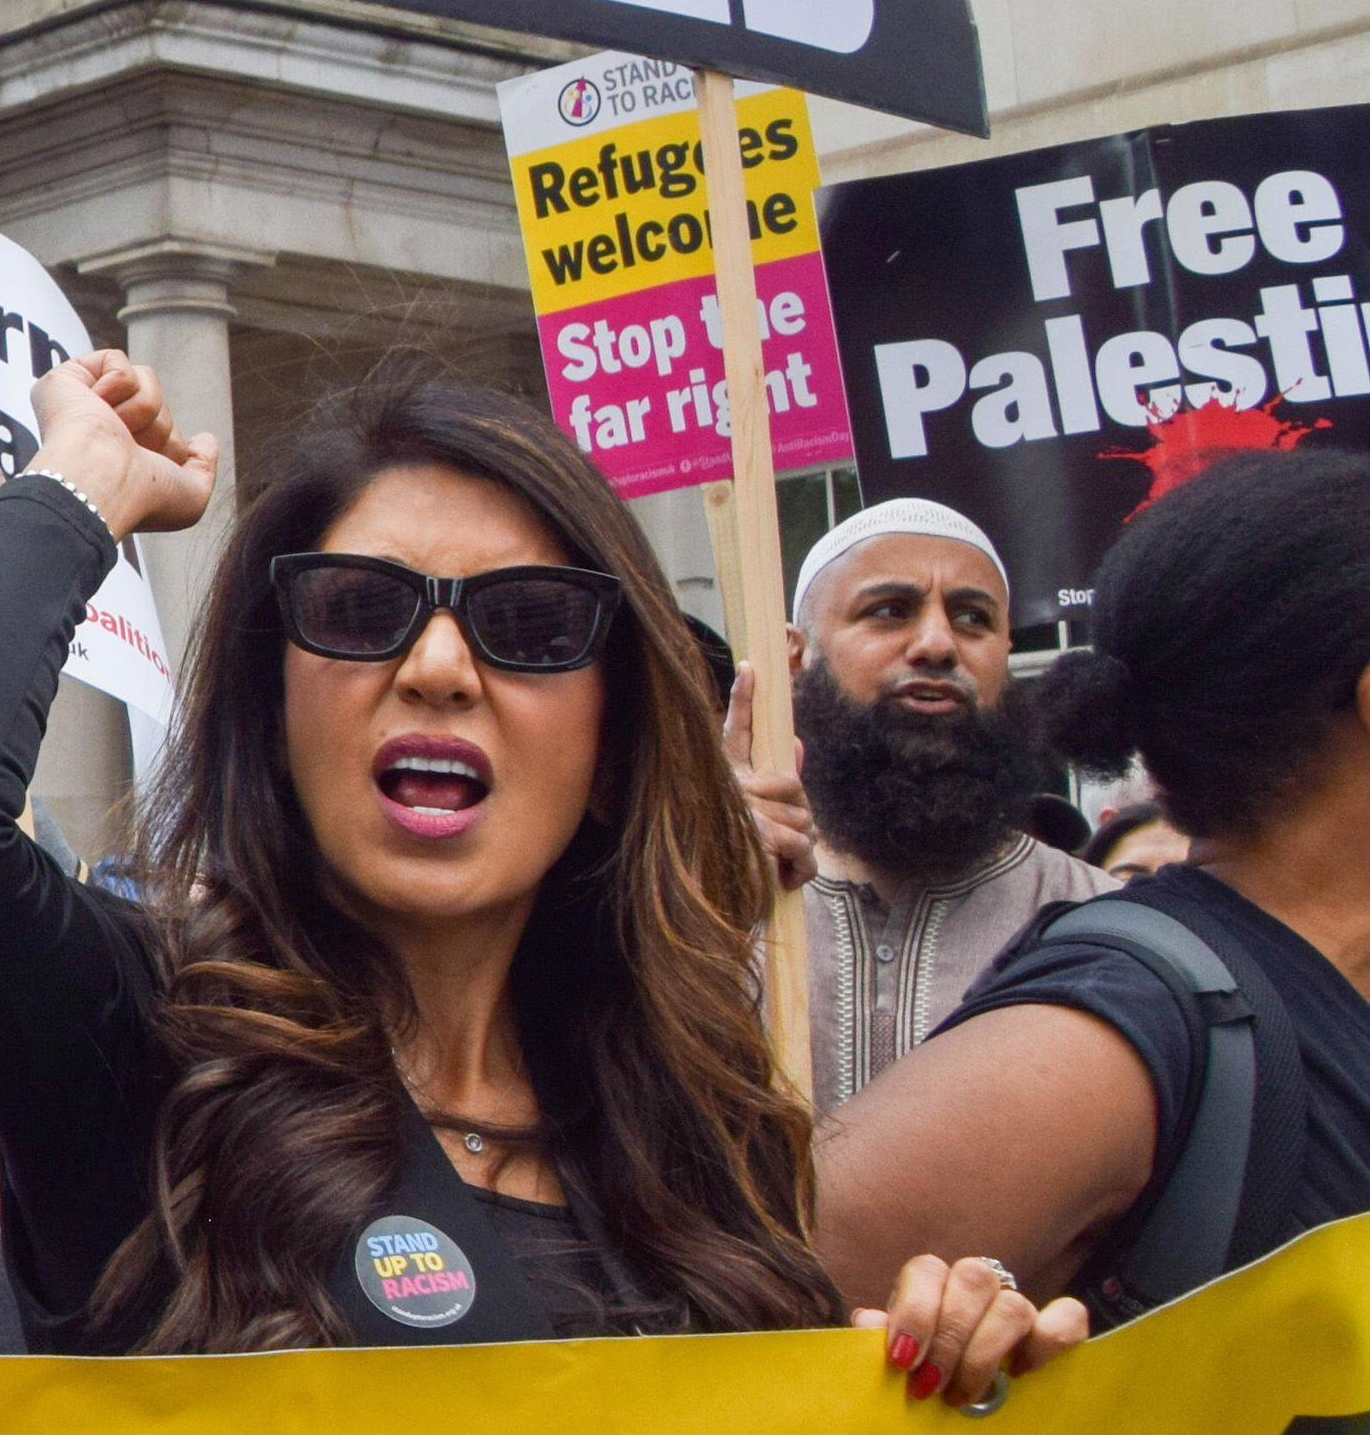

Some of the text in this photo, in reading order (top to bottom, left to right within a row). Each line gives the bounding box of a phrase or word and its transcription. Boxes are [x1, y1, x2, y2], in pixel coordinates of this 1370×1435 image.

[603, 59, 677, 91] STAND
[607, 90, 636, 116] TO
[528, 118, 798, 220] Refuges
[1014, 169, 1346, 303] Free
[557, 313, 686, 383] Stop
[873, 274, 1370, 460] Palesti
[570, 394, 651, 454] far
[367, 1232, 440, 1257] STAND
[373, 1251, 444, 1278] UP TO
[381, 1270, 470, 1299] RACISM
